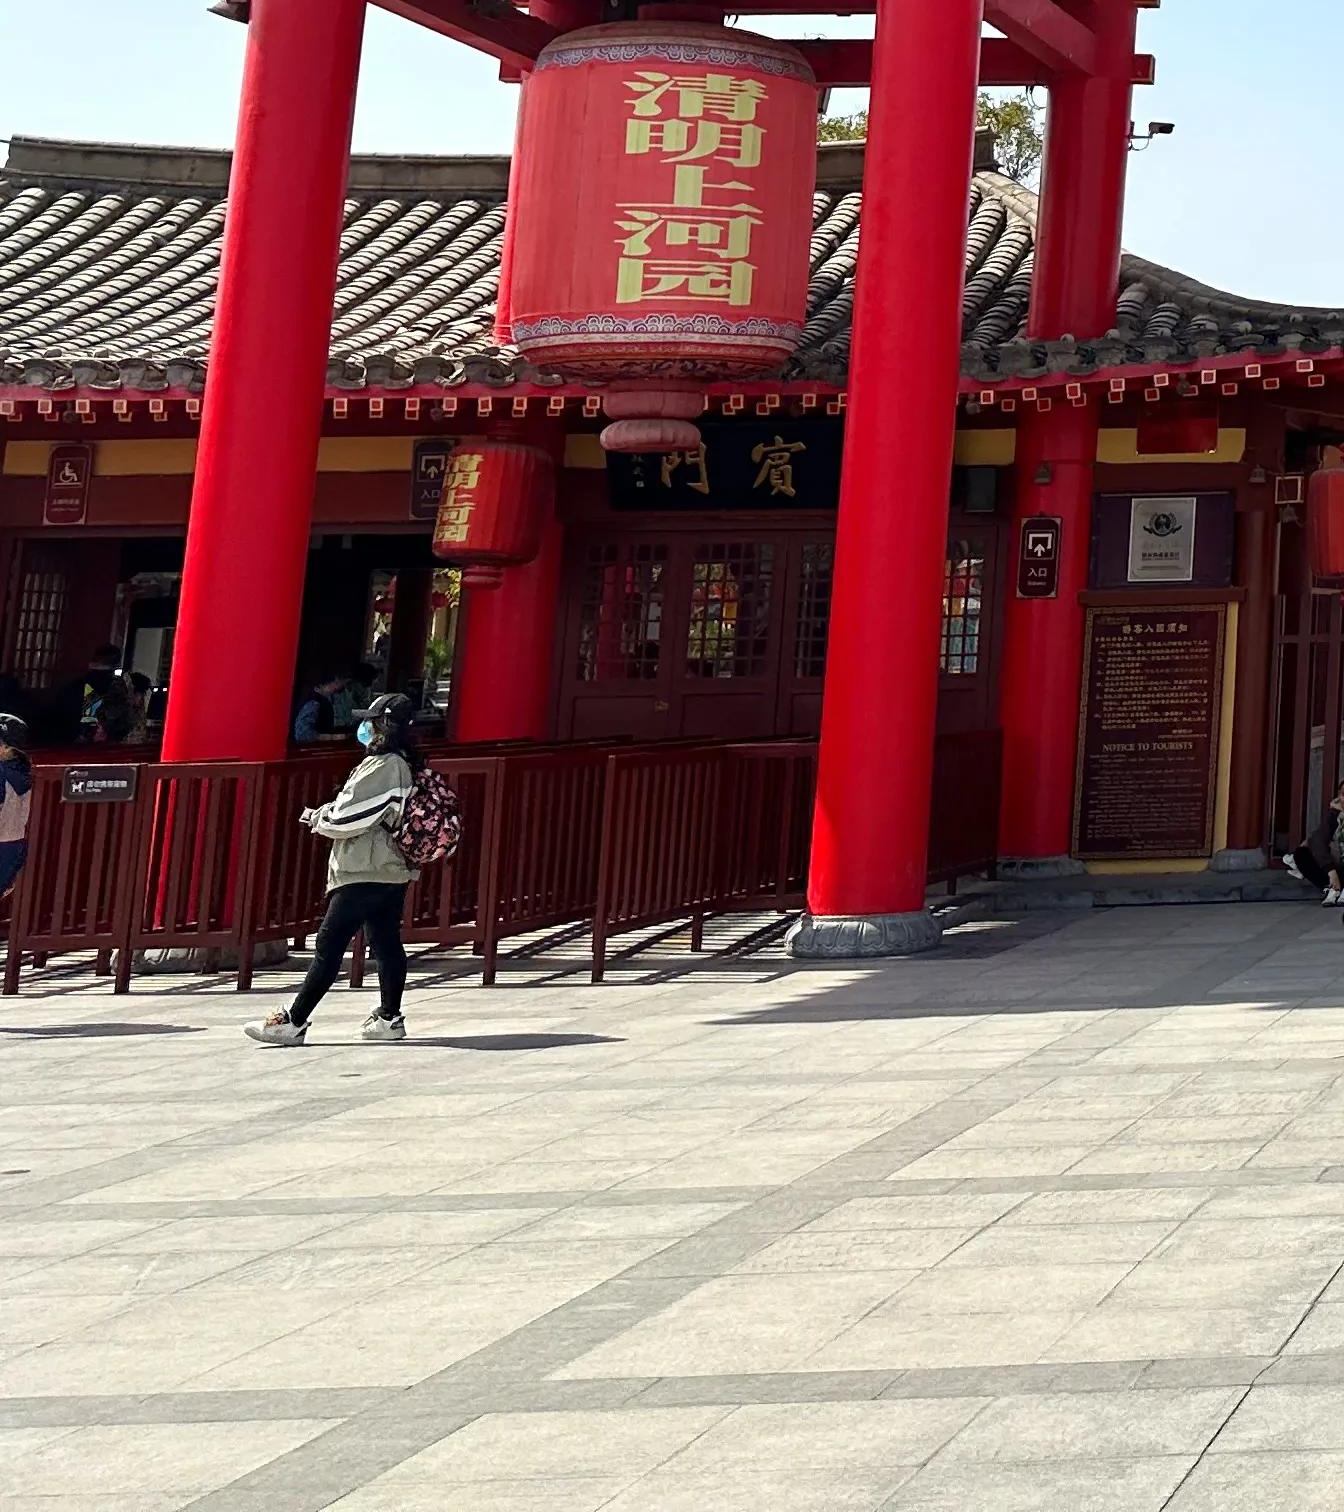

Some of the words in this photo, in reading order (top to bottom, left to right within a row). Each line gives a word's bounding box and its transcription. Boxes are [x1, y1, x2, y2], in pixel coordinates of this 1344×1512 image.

[614, 71, 769, 306] 清明上河园
[1027, 568, 1047, 577] 入口
[1102, 743, 1135, 752] NOTICE
[1137, 743, 1150, 751] TO
[1152, 741, 1193, 751] TOURISTS
